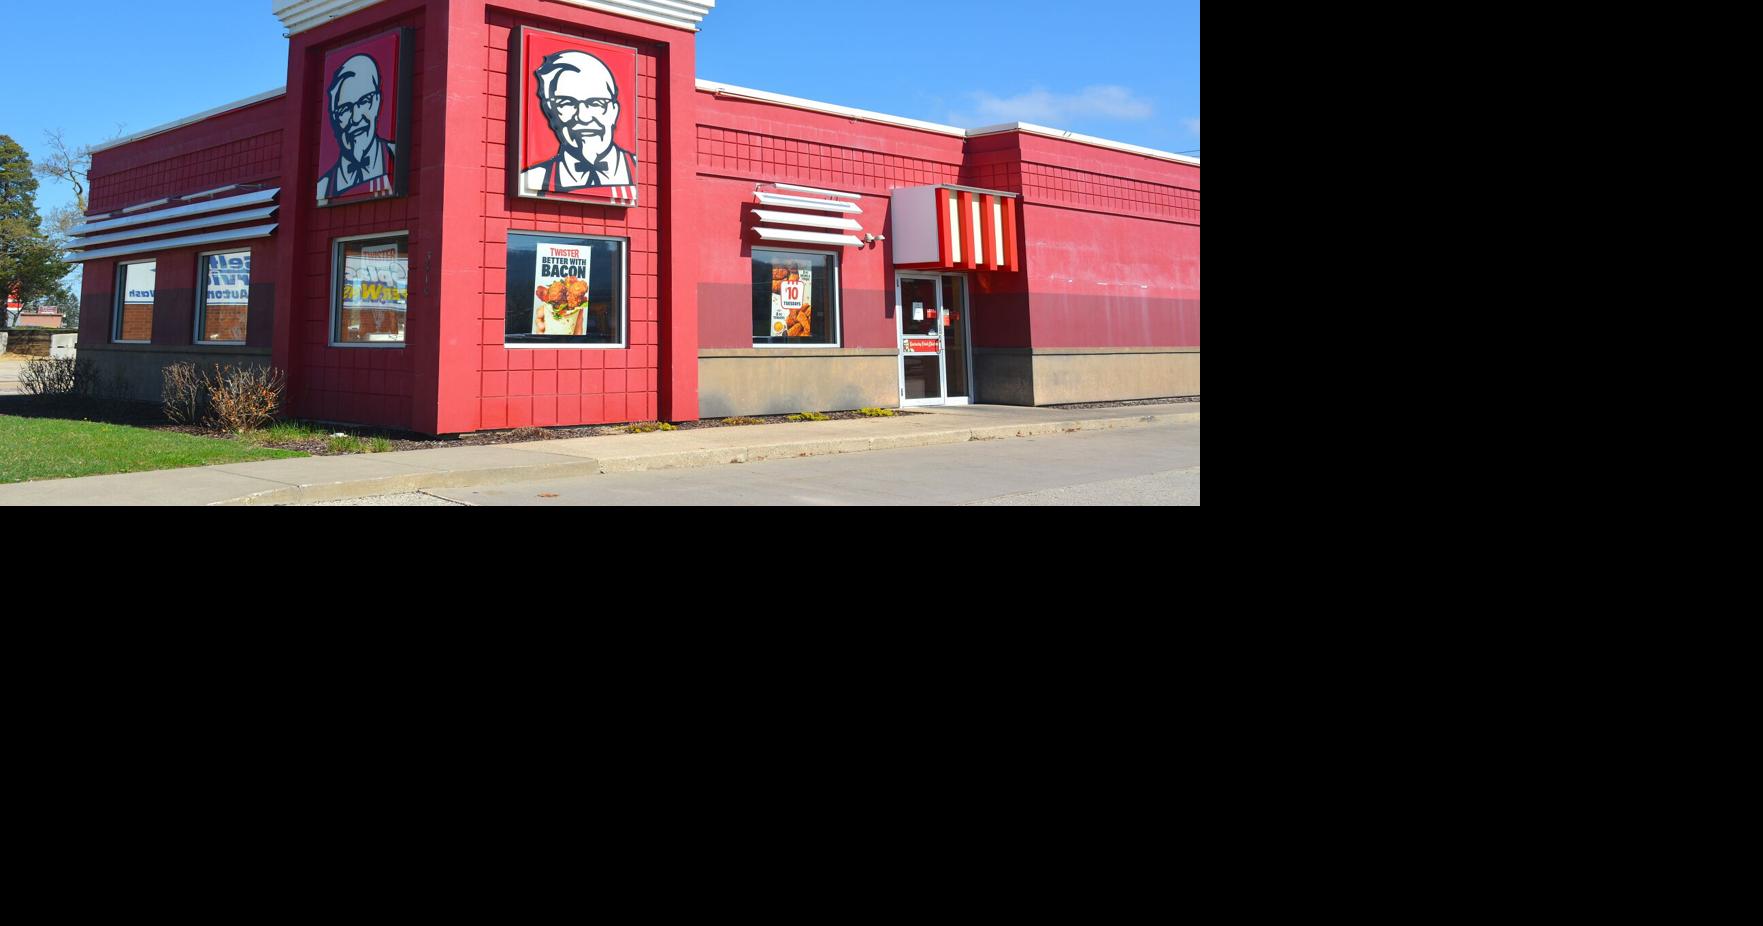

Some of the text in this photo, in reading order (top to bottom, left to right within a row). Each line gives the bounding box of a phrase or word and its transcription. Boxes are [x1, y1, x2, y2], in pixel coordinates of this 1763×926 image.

[550, 247, 579, 258] TWISTER
[542, 256, 568, 264] BETTER
[541, 264, 586, 278] BACON
